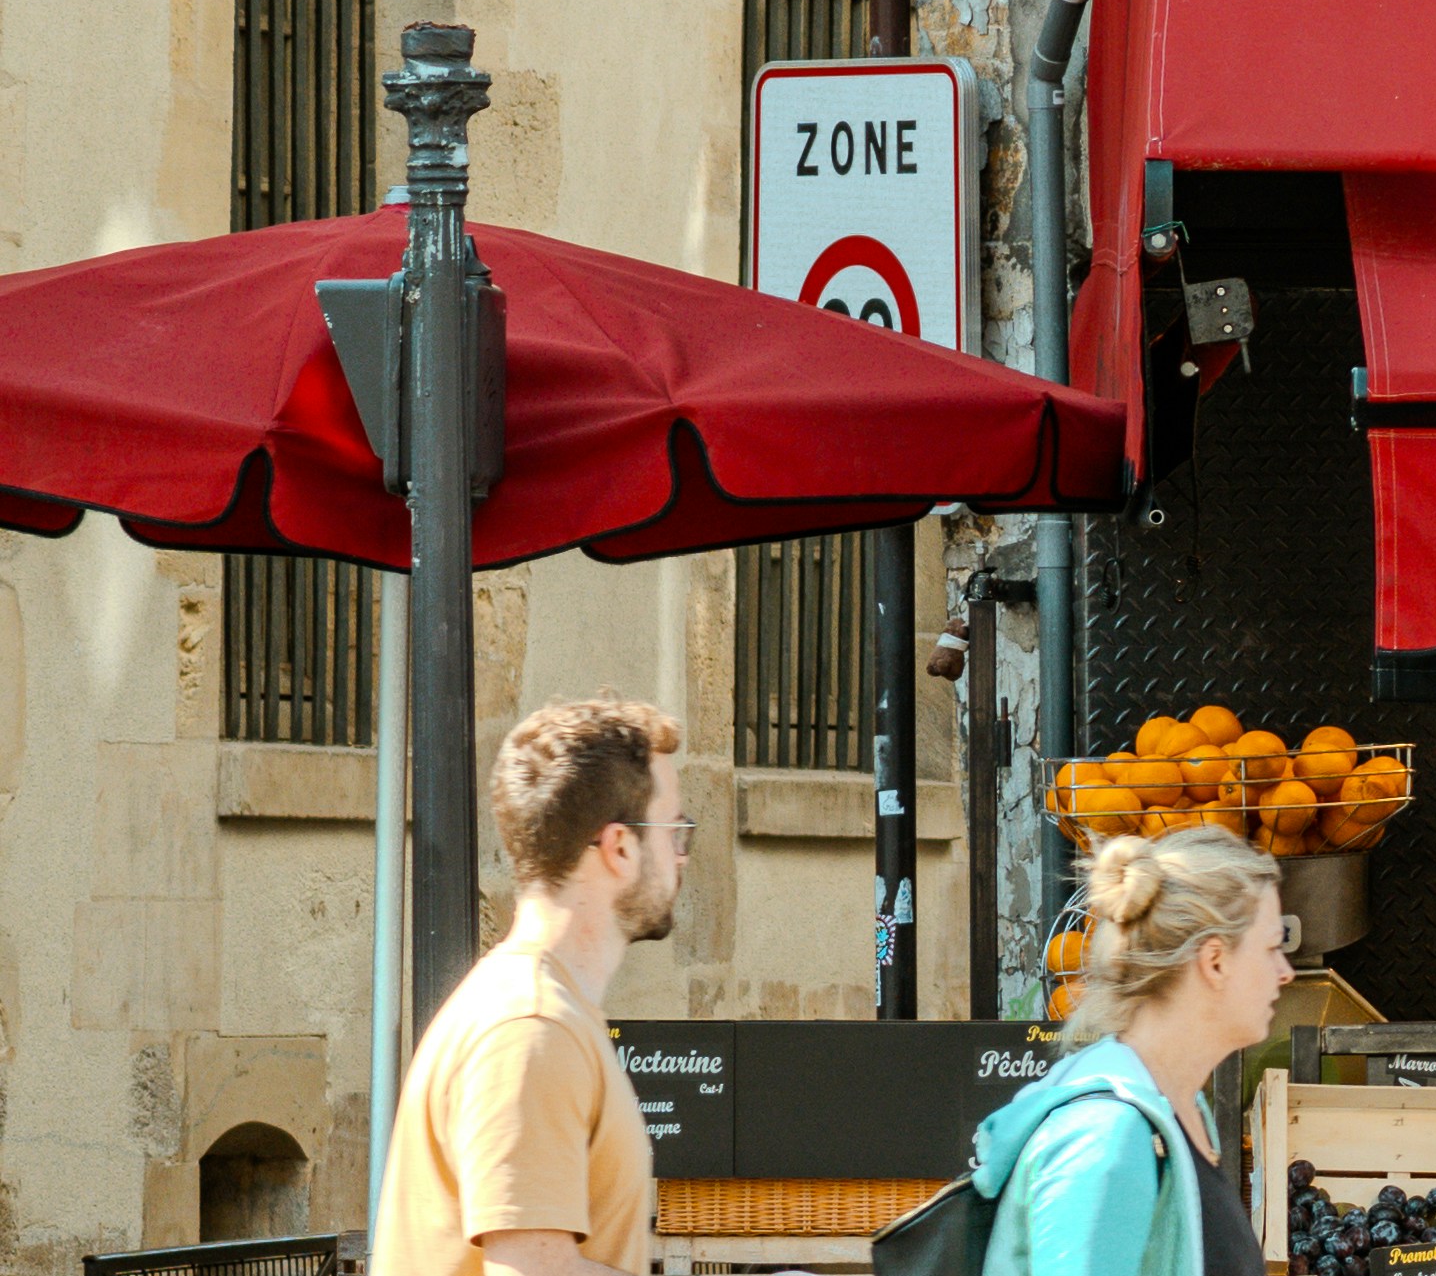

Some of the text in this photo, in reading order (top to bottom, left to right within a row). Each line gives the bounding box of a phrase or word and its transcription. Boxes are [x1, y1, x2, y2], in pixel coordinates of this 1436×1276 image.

[797, 120, 918, 176] ZONE
[615, 1045, 1048, 1077] Nectarine Pêche
[637, 1096, 674, 1112] aune
